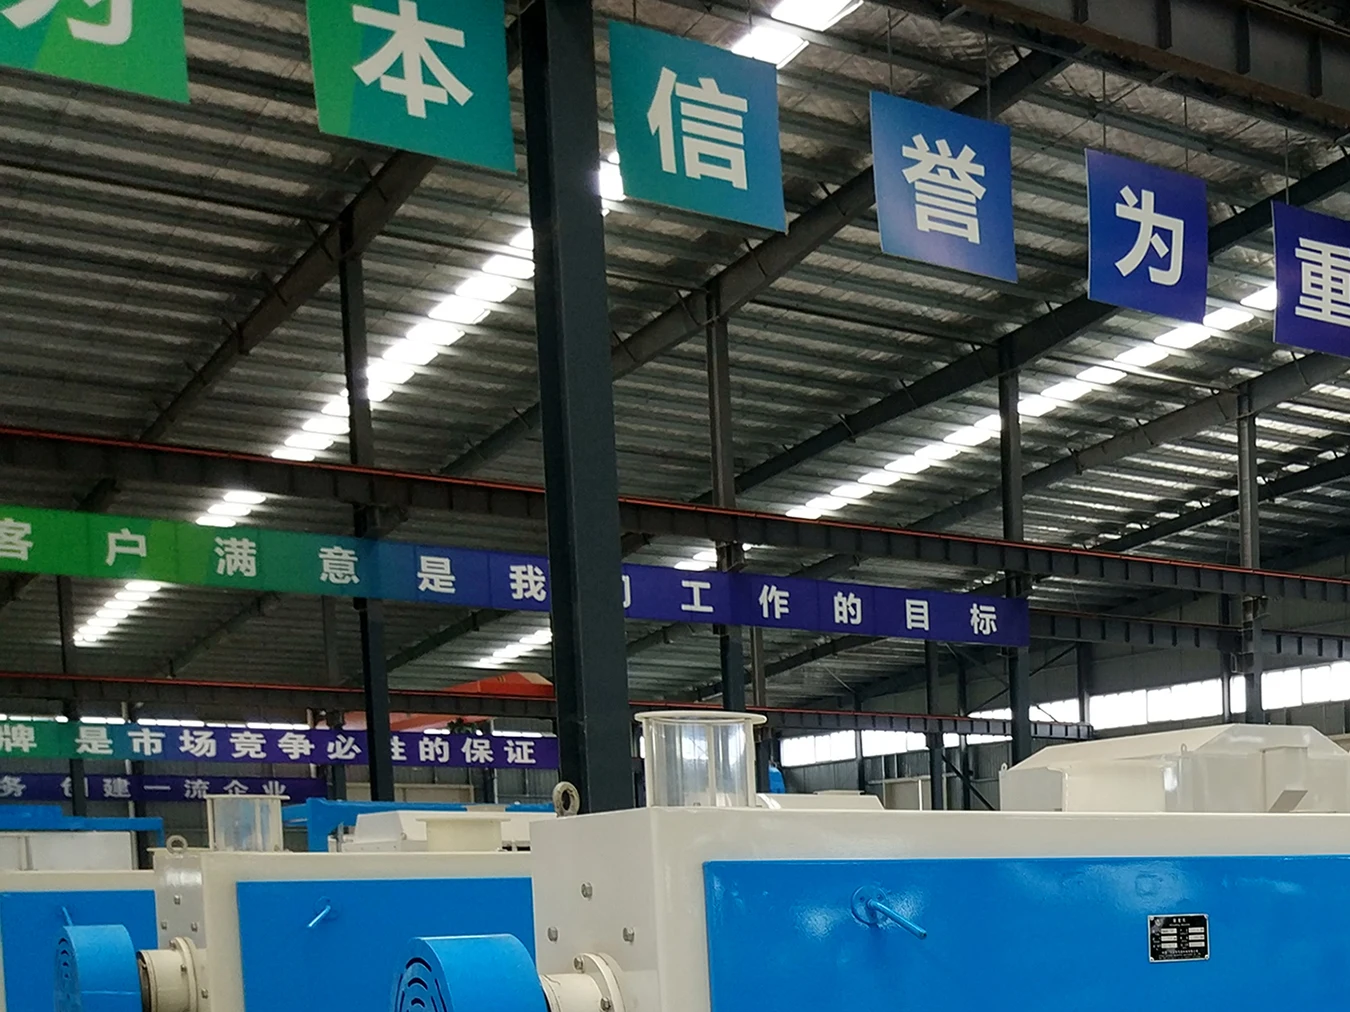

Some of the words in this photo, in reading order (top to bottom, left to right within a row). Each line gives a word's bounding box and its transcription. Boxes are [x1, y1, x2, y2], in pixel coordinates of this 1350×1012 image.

[352, 0, 473, 118] 本
[647, 67, 749, 191] 信
[901, 133, 987, 244] 誉
[1114, 185, 1185, 286] 为
[0, 518, 998, 636] 客户满意是我工作的目标
[0, 723, 37, 753] 牌
